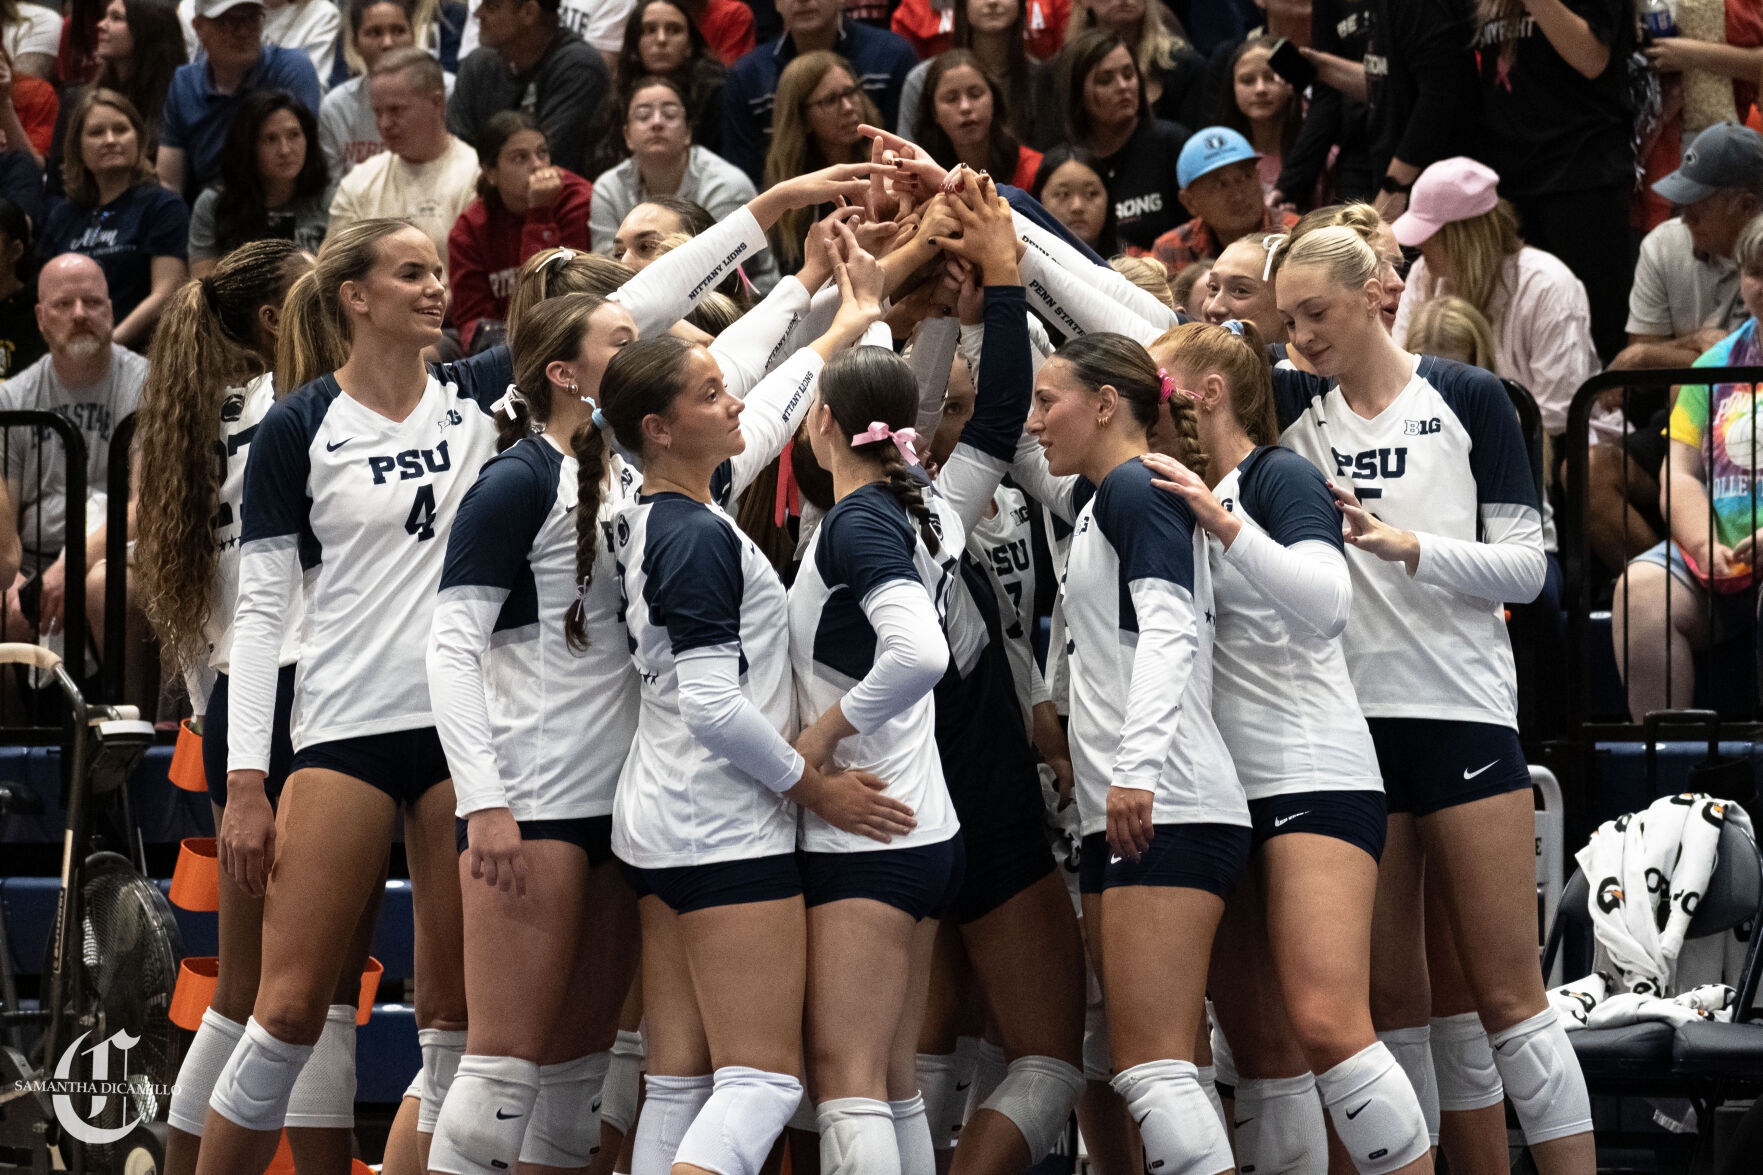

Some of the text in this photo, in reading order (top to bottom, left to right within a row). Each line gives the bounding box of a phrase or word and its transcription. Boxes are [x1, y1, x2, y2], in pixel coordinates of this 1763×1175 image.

[688, 242, 747, 300] NITTANY LIONS
[1029, 280, 1086, 337] PENN STATE
[765, 334, 786, 371] NITTANY
[798, 370, 814, 394] LIONS
[368, 439, 451, 485] PSU
[1331, 447, 1408, 480] PSU
[404, 483, 436, 543] 4
